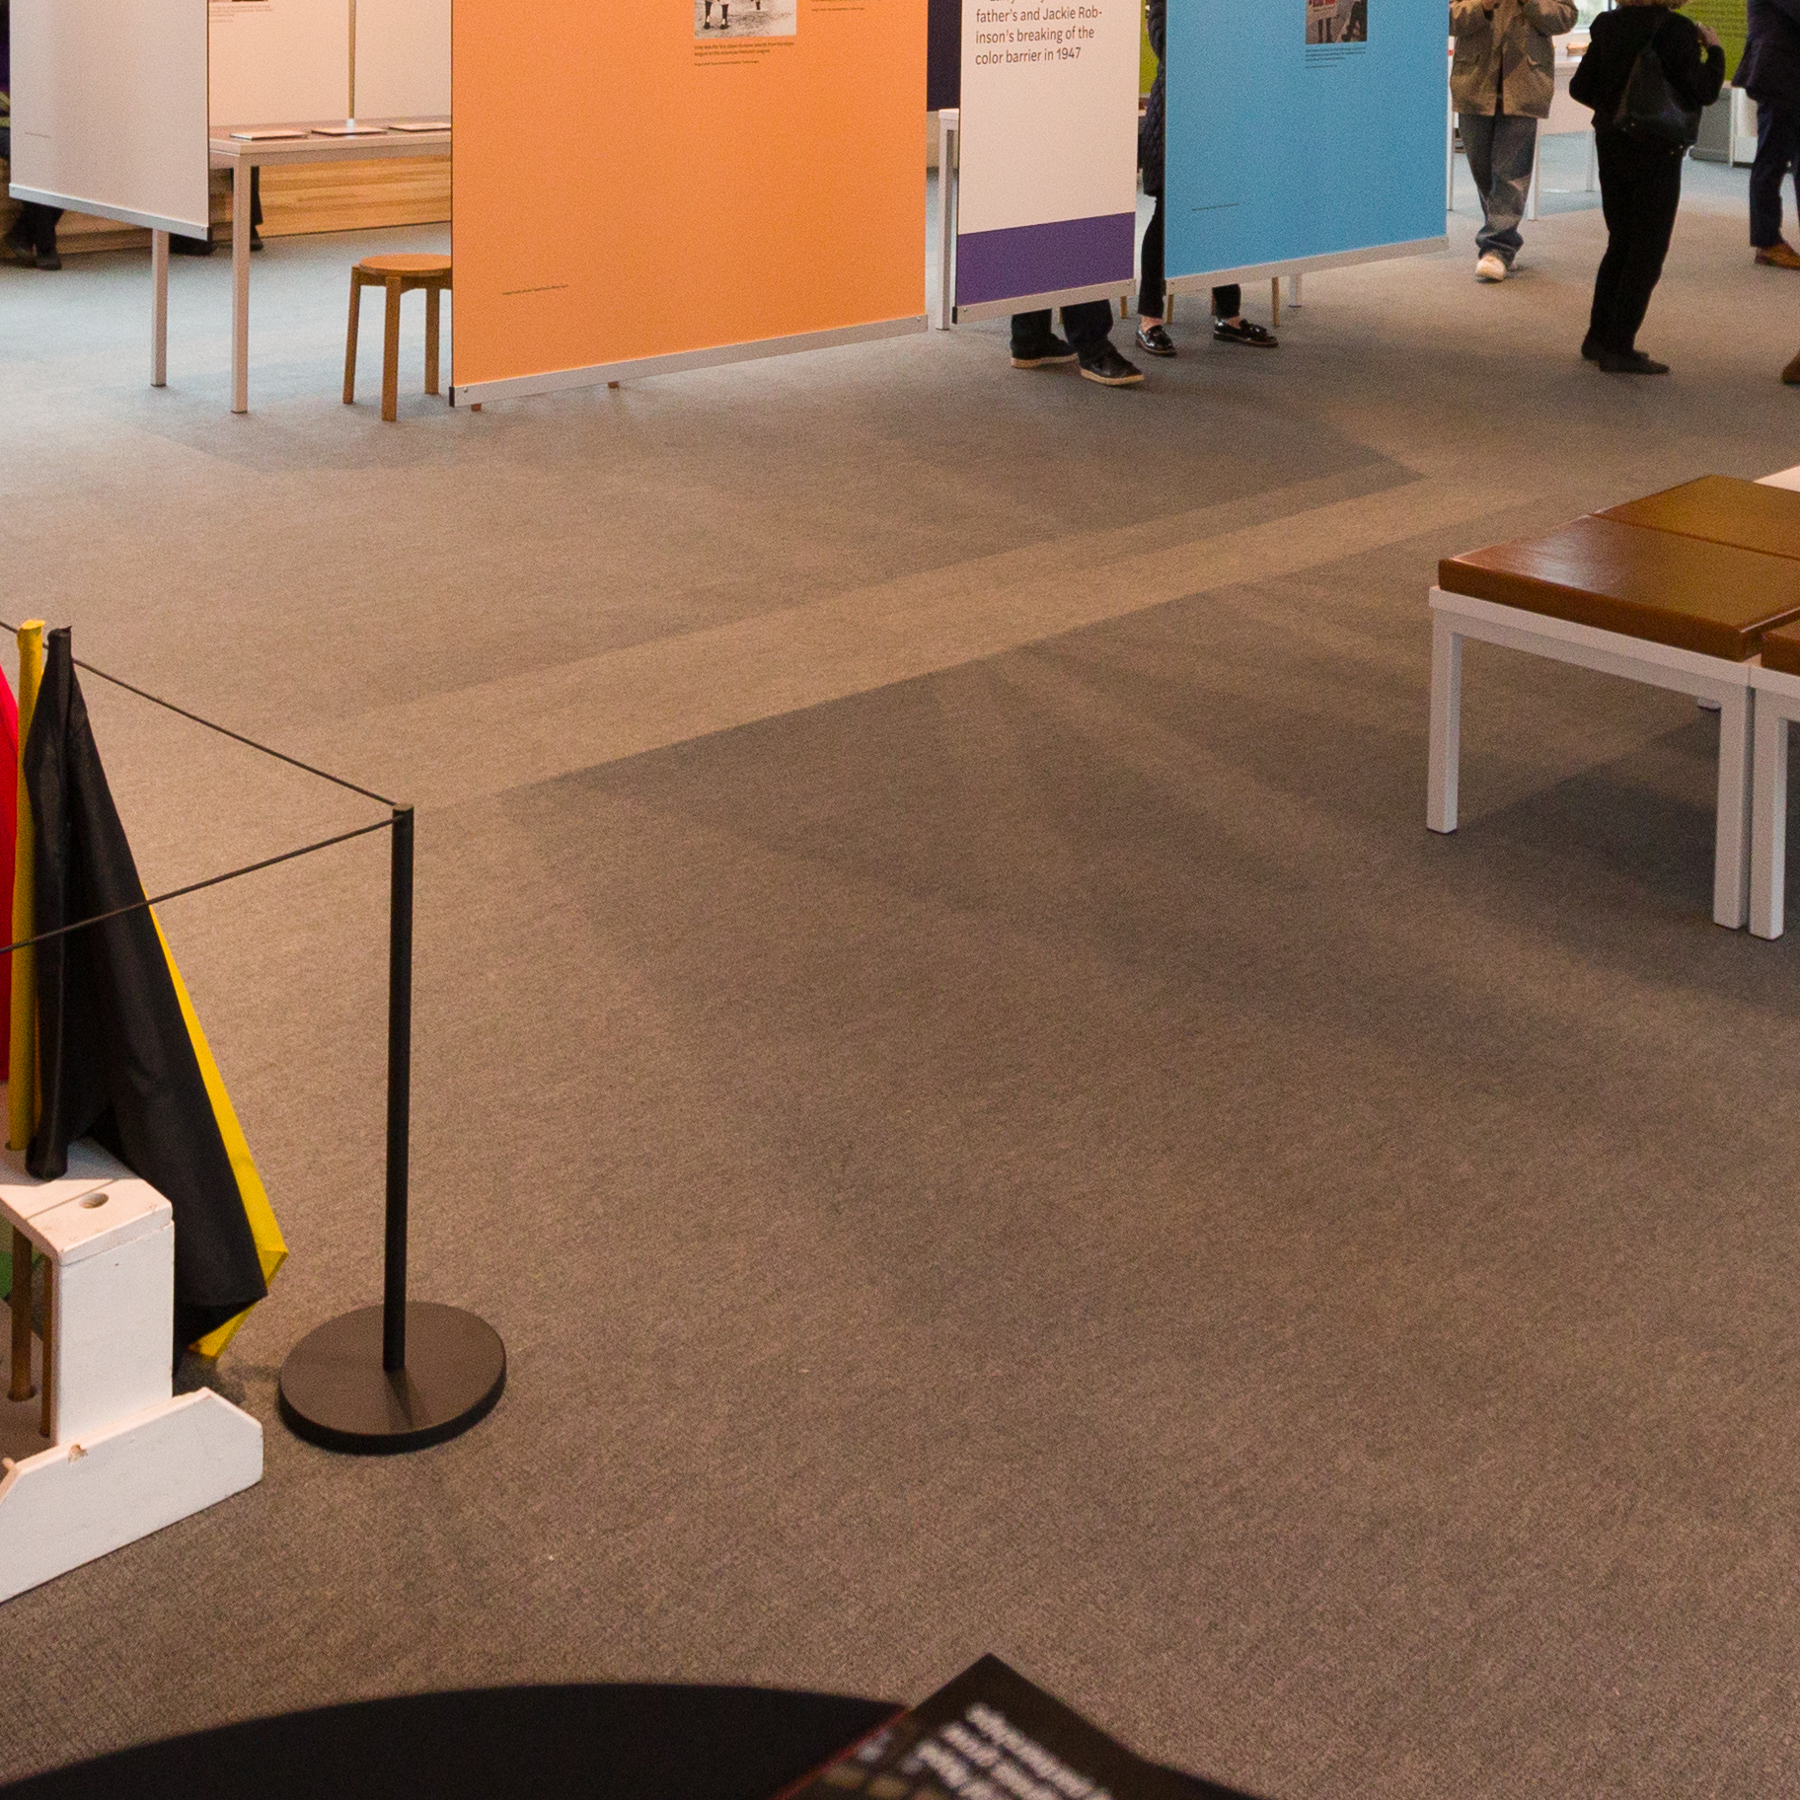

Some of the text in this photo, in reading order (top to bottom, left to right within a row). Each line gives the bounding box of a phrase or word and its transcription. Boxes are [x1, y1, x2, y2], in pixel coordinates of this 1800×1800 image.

[976, 6, 1102, 23] father's and Jackie Rob-
[976, 26, 1094, 44] inson's breaking of the
[976, 47, 1081, 65] color barrier in 1947
